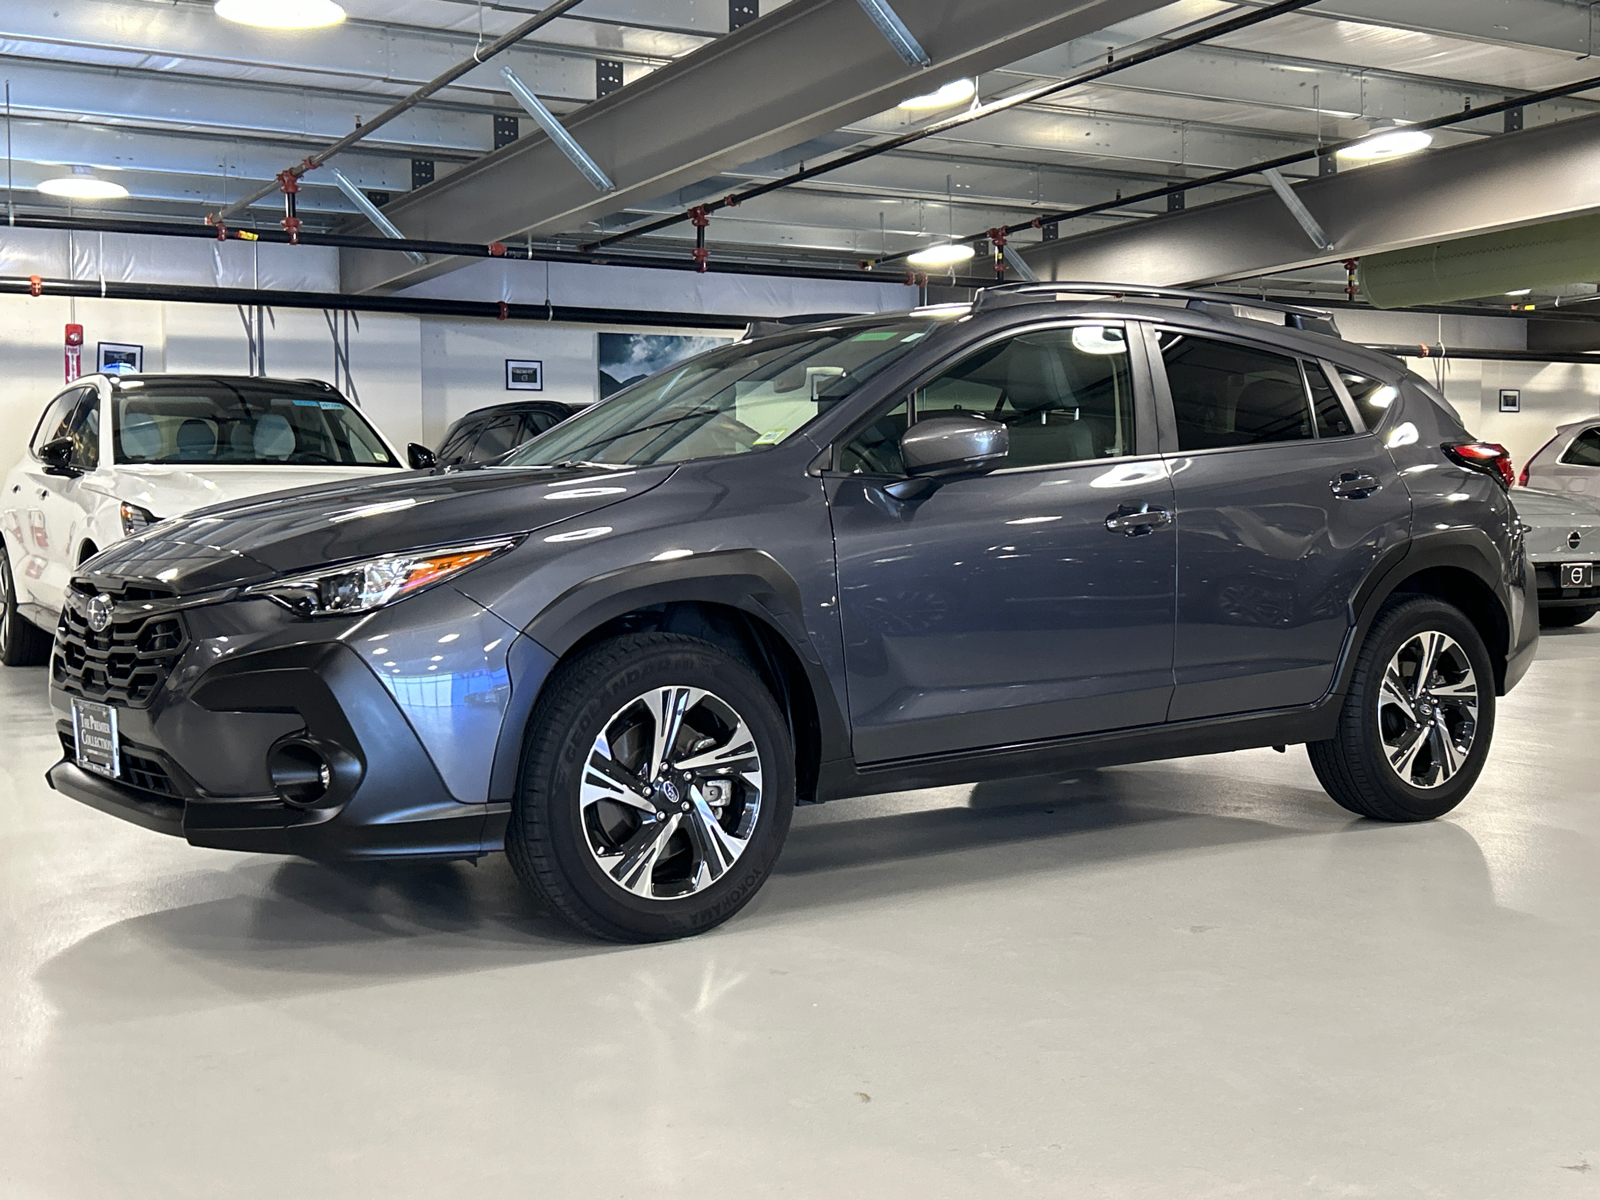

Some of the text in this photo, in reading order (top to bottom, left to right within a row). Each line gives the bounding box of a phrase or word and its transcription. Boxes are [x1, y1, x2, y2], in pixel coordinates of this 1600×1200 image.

[79, 713, 111, 734] THE PREMIER
[81, 729, 113, 751] COLLECTION
[689, 868, 762, 925] YOKOHAMA
